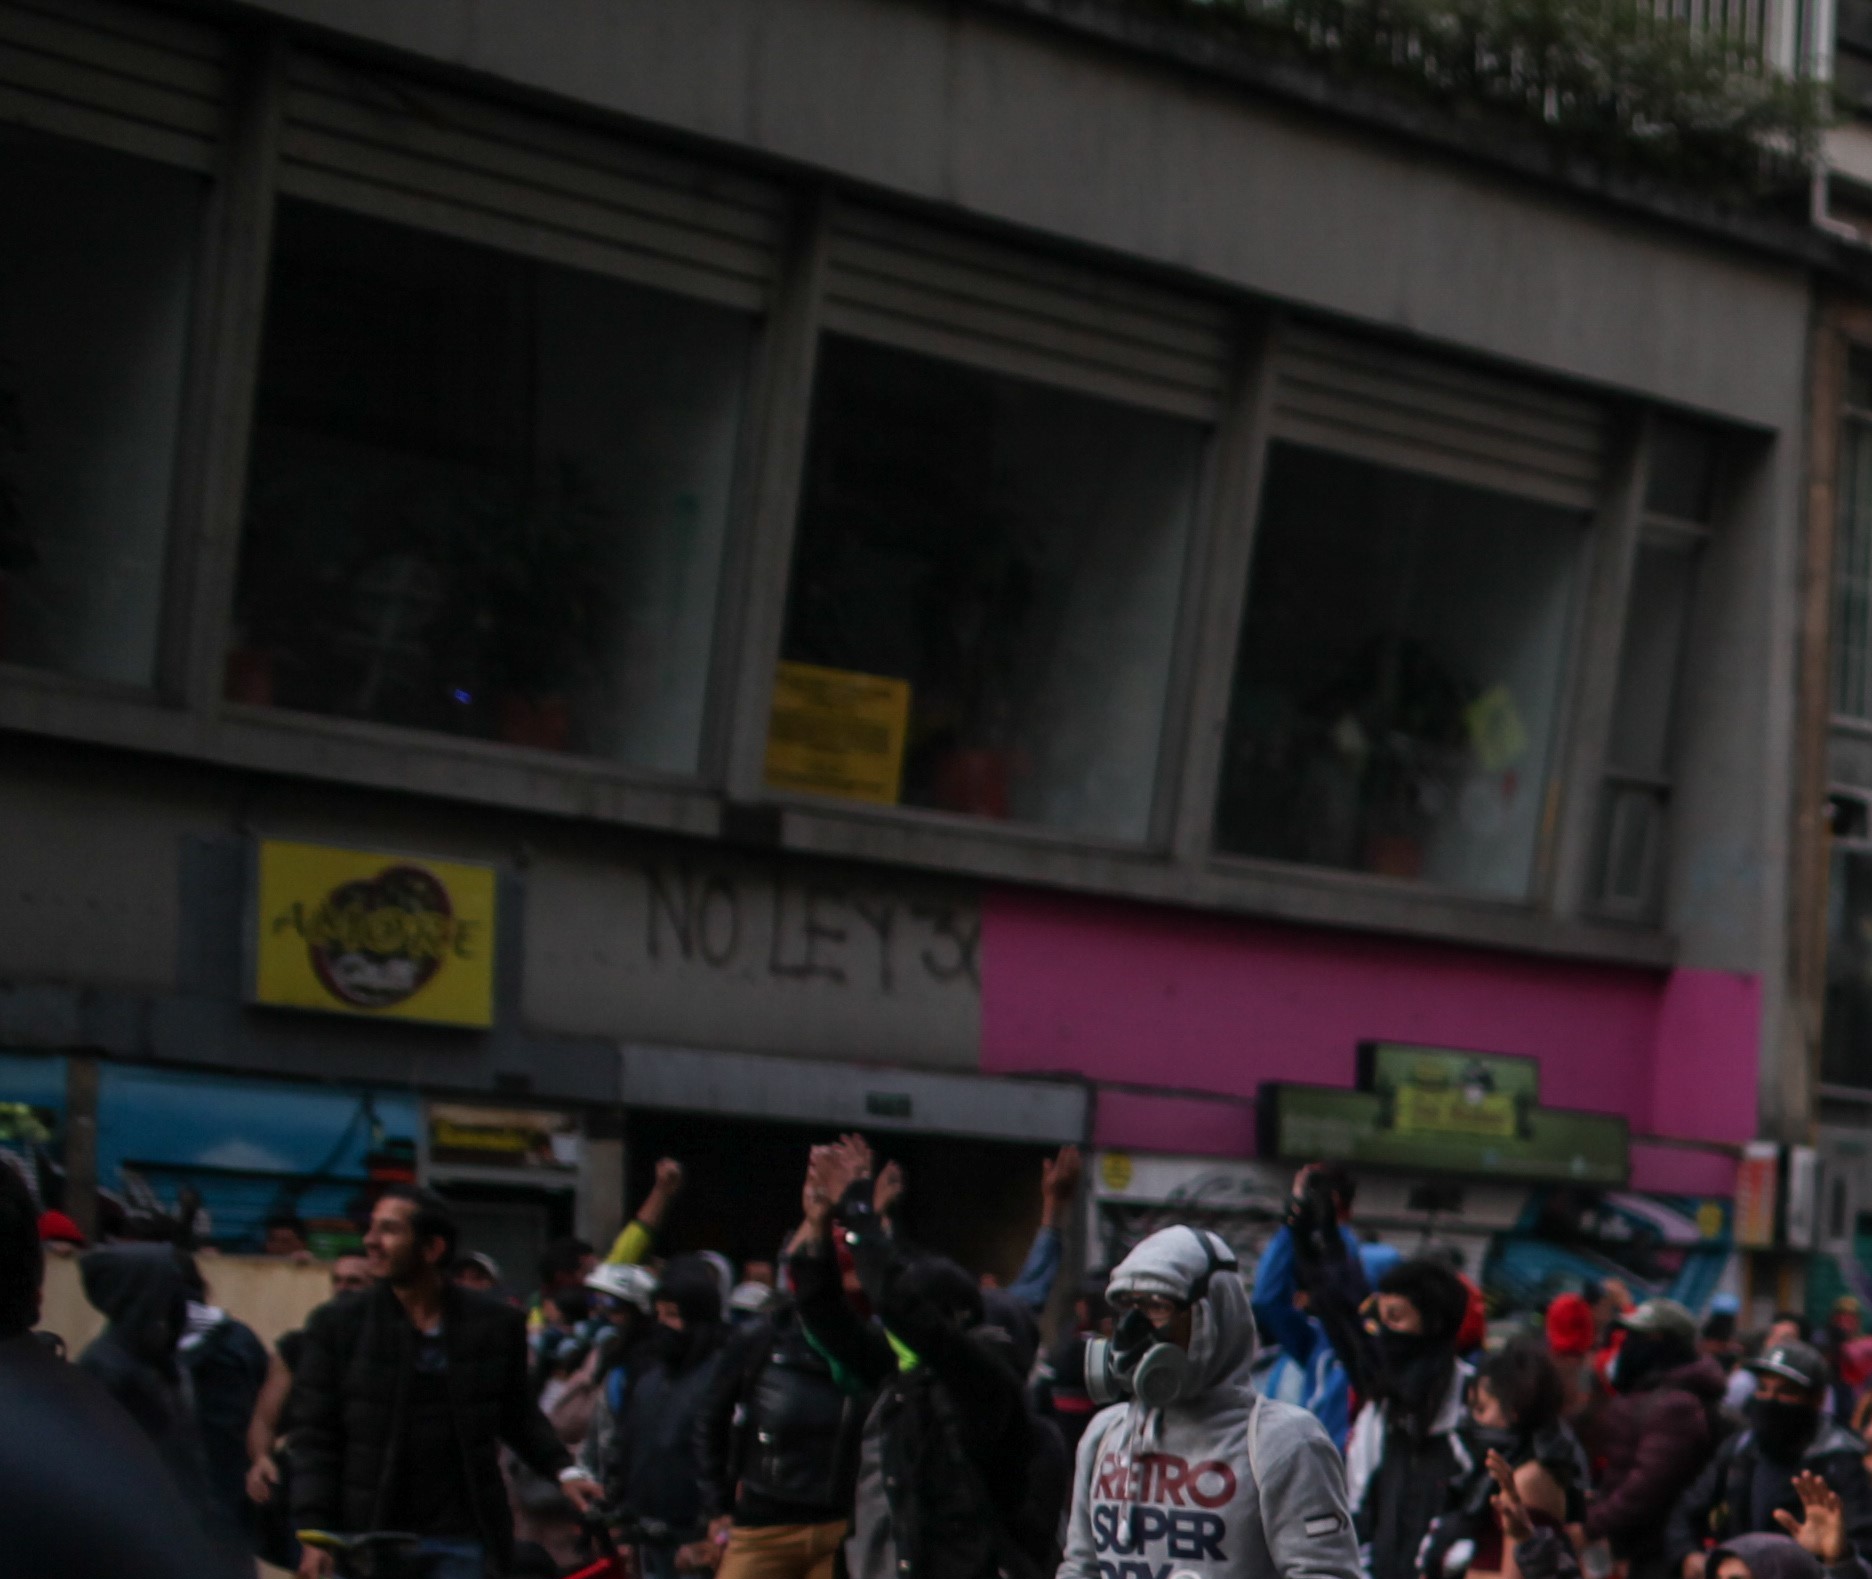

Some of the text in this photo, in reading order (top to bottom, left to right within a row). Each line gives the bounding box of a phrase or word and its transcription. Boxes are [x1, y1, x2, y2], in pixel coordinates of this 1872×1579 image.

[643, 859, 741, 968] NO
[768, 869, 893, 995] LEY
[1093, 1452, 1237, 1508] RETRO
[1094, 1504, 1229, 1561] SUPER
